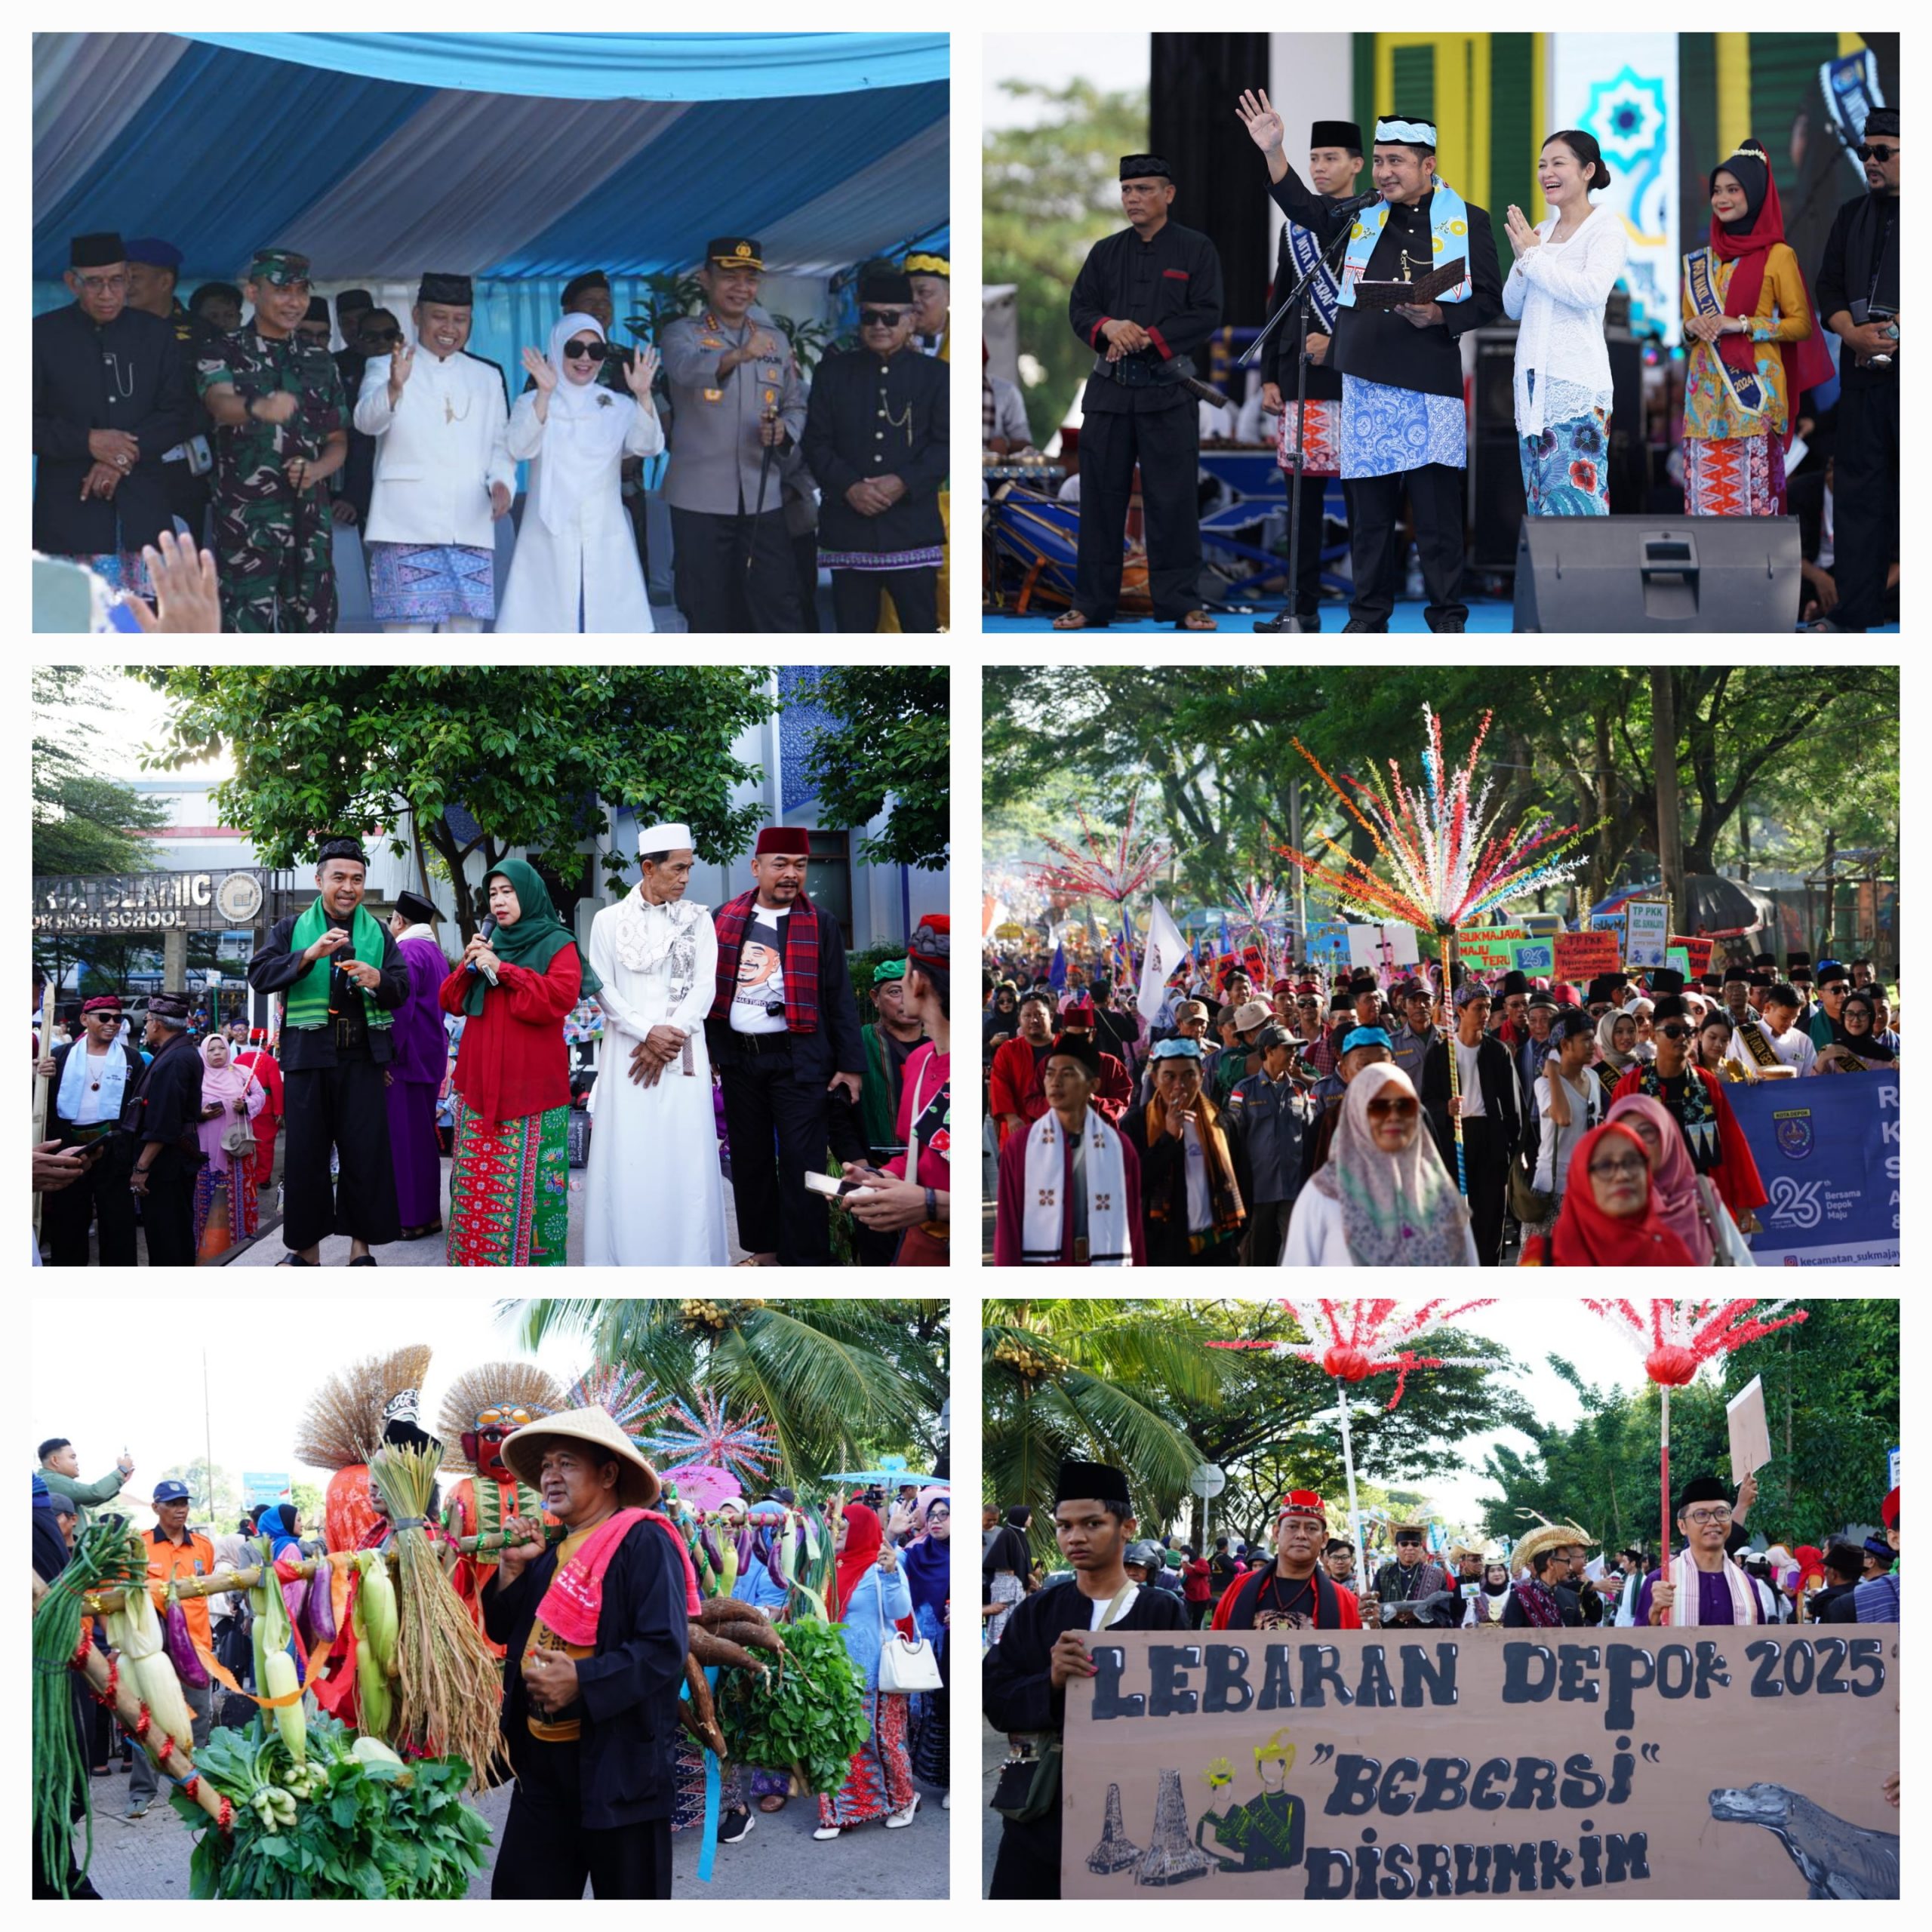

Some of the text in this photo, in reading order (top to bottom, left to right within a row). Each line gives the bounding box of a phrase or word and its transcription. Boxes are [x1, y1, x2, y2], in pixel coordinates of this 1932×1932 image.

[1296, 235, 1313, 263] DUTA
[1734, 376, 1755, 393] 2024
[1633, 906, 1663, 916] TP PKK
[56, 912, 102, 929] HIGH
[107, 910, 187, 928] SCHOOL
[1460, 929, 1522, 943] SUKMAJAYA
[1569, 935, 1603, 946] TP PKK
[1460, 945, 1489, 956] MAJU
[1825, 1189, 1861, 1200] Bersama
[1826, 1200, 1853, 1211] Depok
[1828, 1211, 1847, 1221] Maju
[1091, 1643, 1459, 1721] LEBARAN
[1745, 1637, 1885, 1697] 2025
